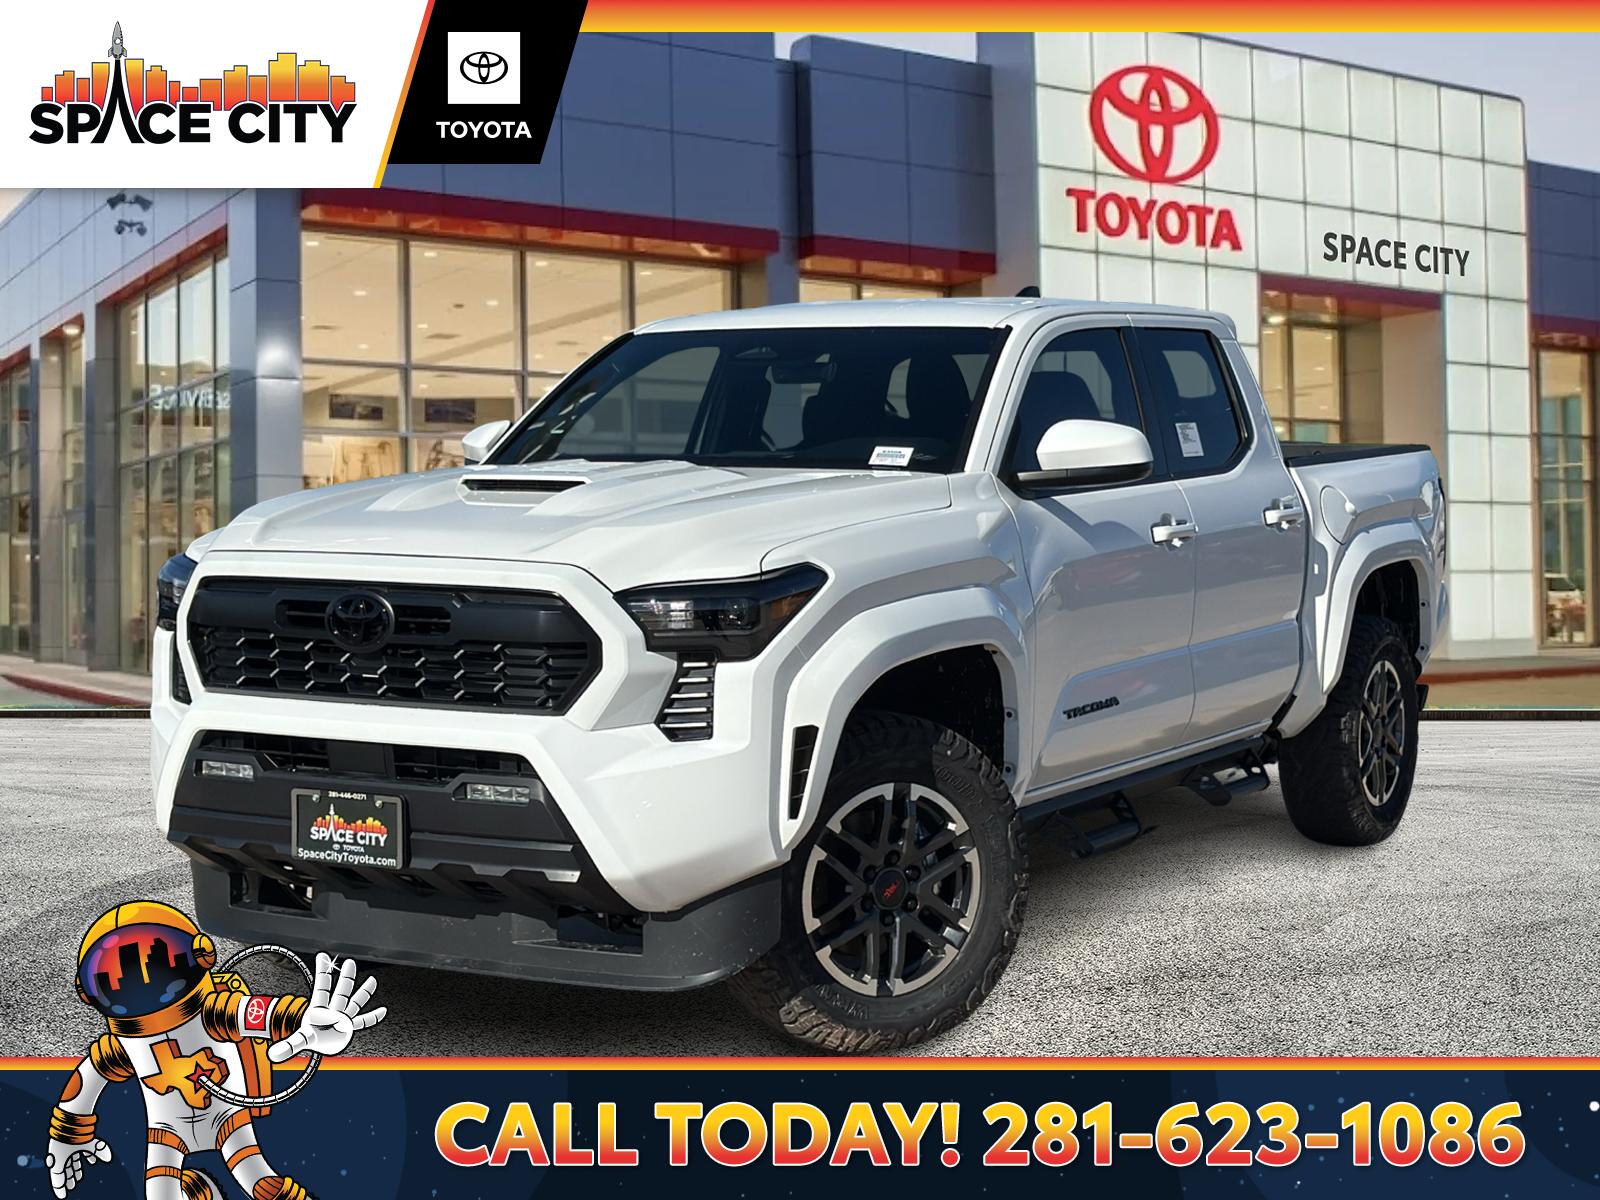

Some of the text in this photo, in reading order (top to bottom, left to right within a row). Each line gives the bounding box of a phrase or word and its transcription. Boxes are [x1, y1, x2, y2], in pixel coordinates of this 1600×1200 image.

[1065, 188, 1242, 251] TOYOTA
[1323, 232, 1470, 276] SPACE CITY
[1063, 696, 1120, 720] TACOMA
[310, 826, 388, 847] SPACE CITY
[297, 848, 397, 867] SpaceCityToyota.com
[342, 845, 365, 853] TOYOTA
